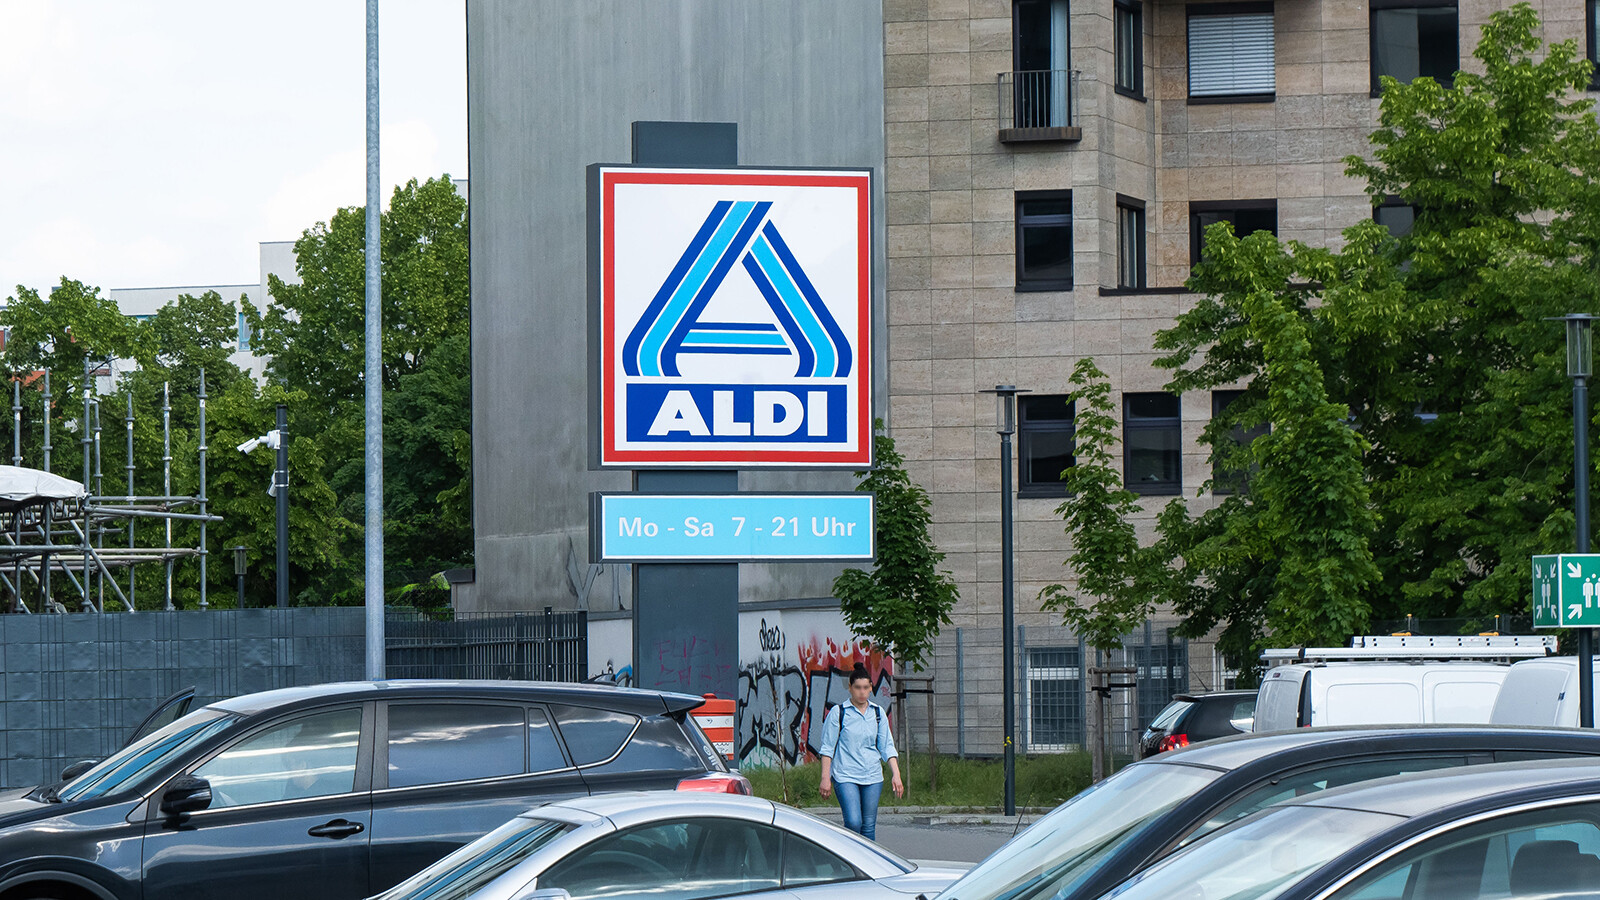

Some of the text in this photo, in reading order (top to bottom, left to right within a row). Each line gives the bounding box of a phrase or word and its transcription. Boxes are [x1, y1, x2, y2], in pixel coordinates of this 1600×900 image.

[646, 390, 828, 436] ALDI
[618, 516, 659, 538] Mo
[684, 516, 715, 538] Sa
[731, 516, 746, 537] 7
[771, 516, 799, 537] 21
[811, 516, 857, 538] Uhr
